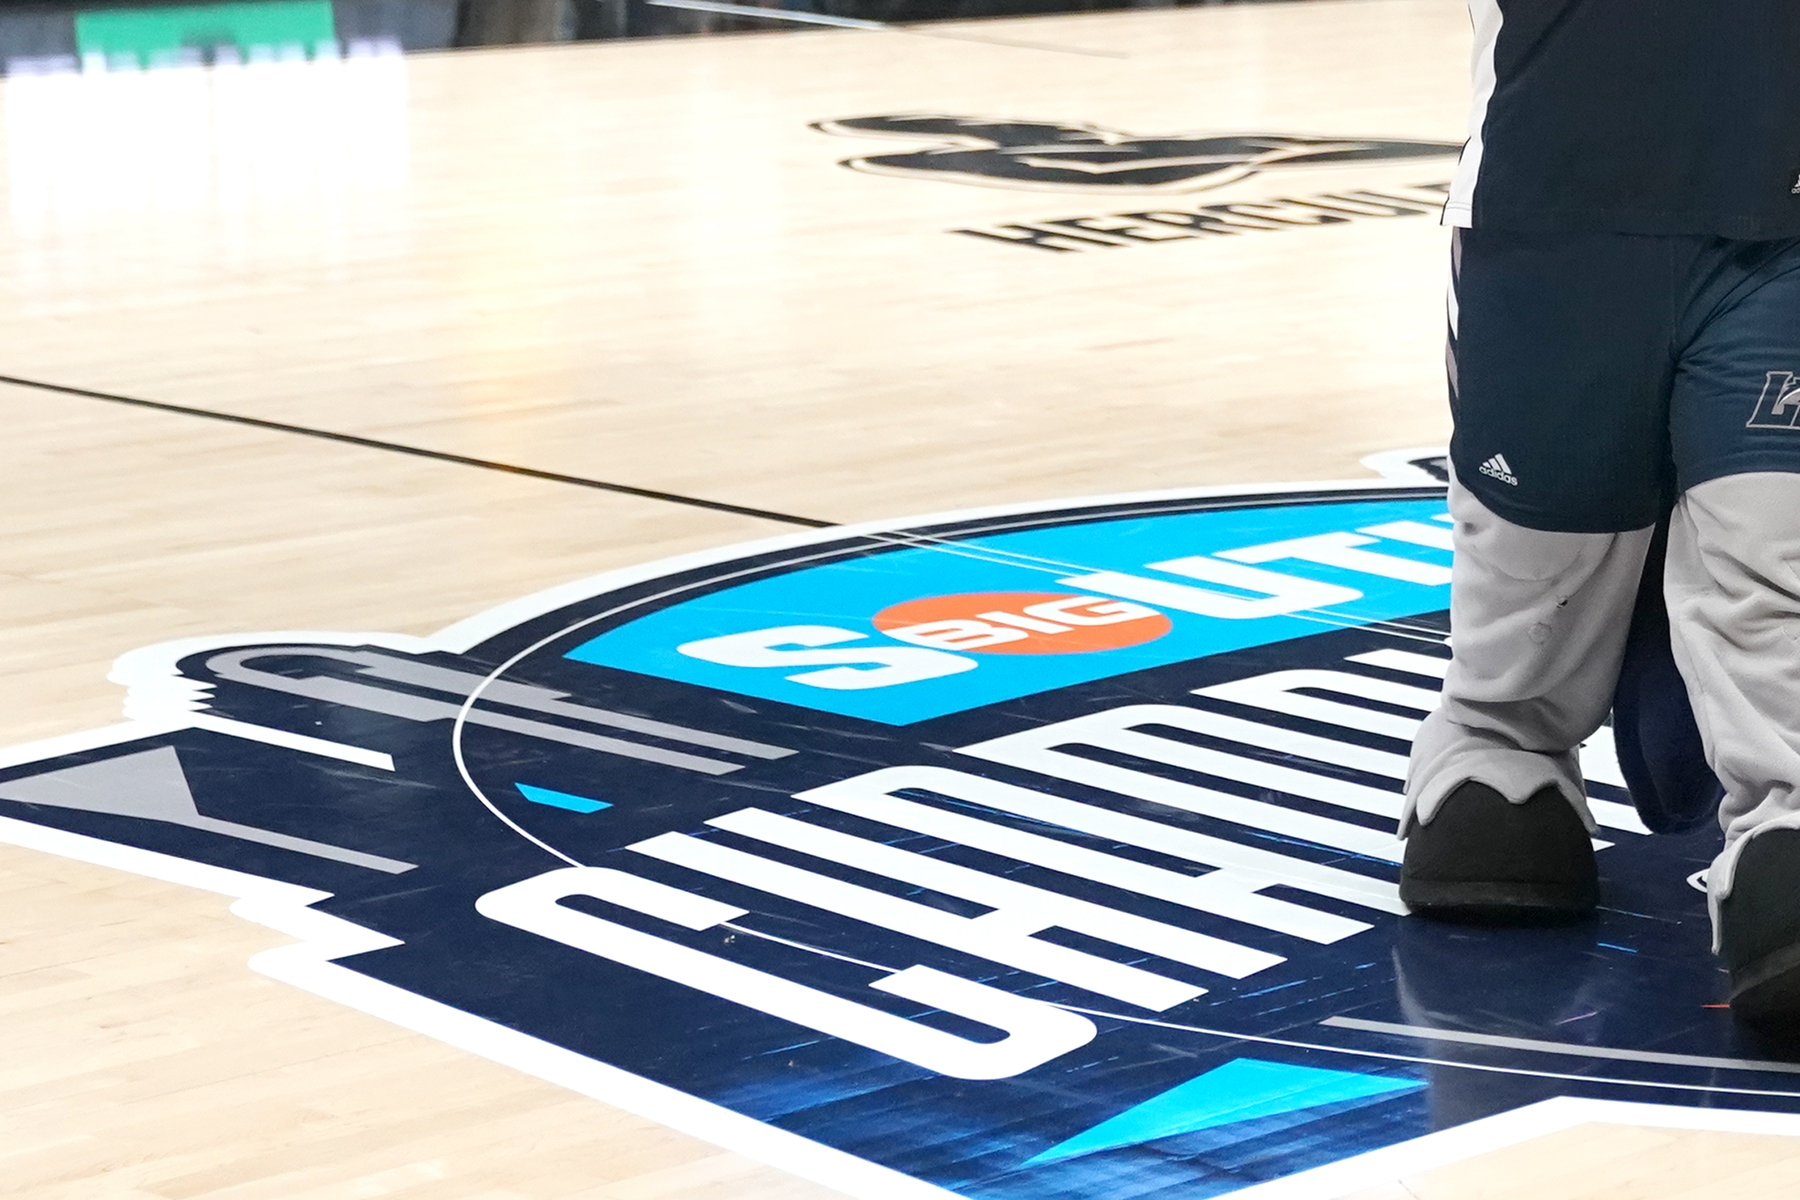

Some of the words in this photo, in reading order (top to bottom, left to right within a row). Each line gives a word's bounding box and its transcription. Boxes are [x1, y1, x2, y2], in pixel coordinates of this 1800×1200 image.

[942, 181, 1452, 254] HERCU
[1478, 465, 1518, 486] adidas
[876, 596, 1163, 651] BIG
